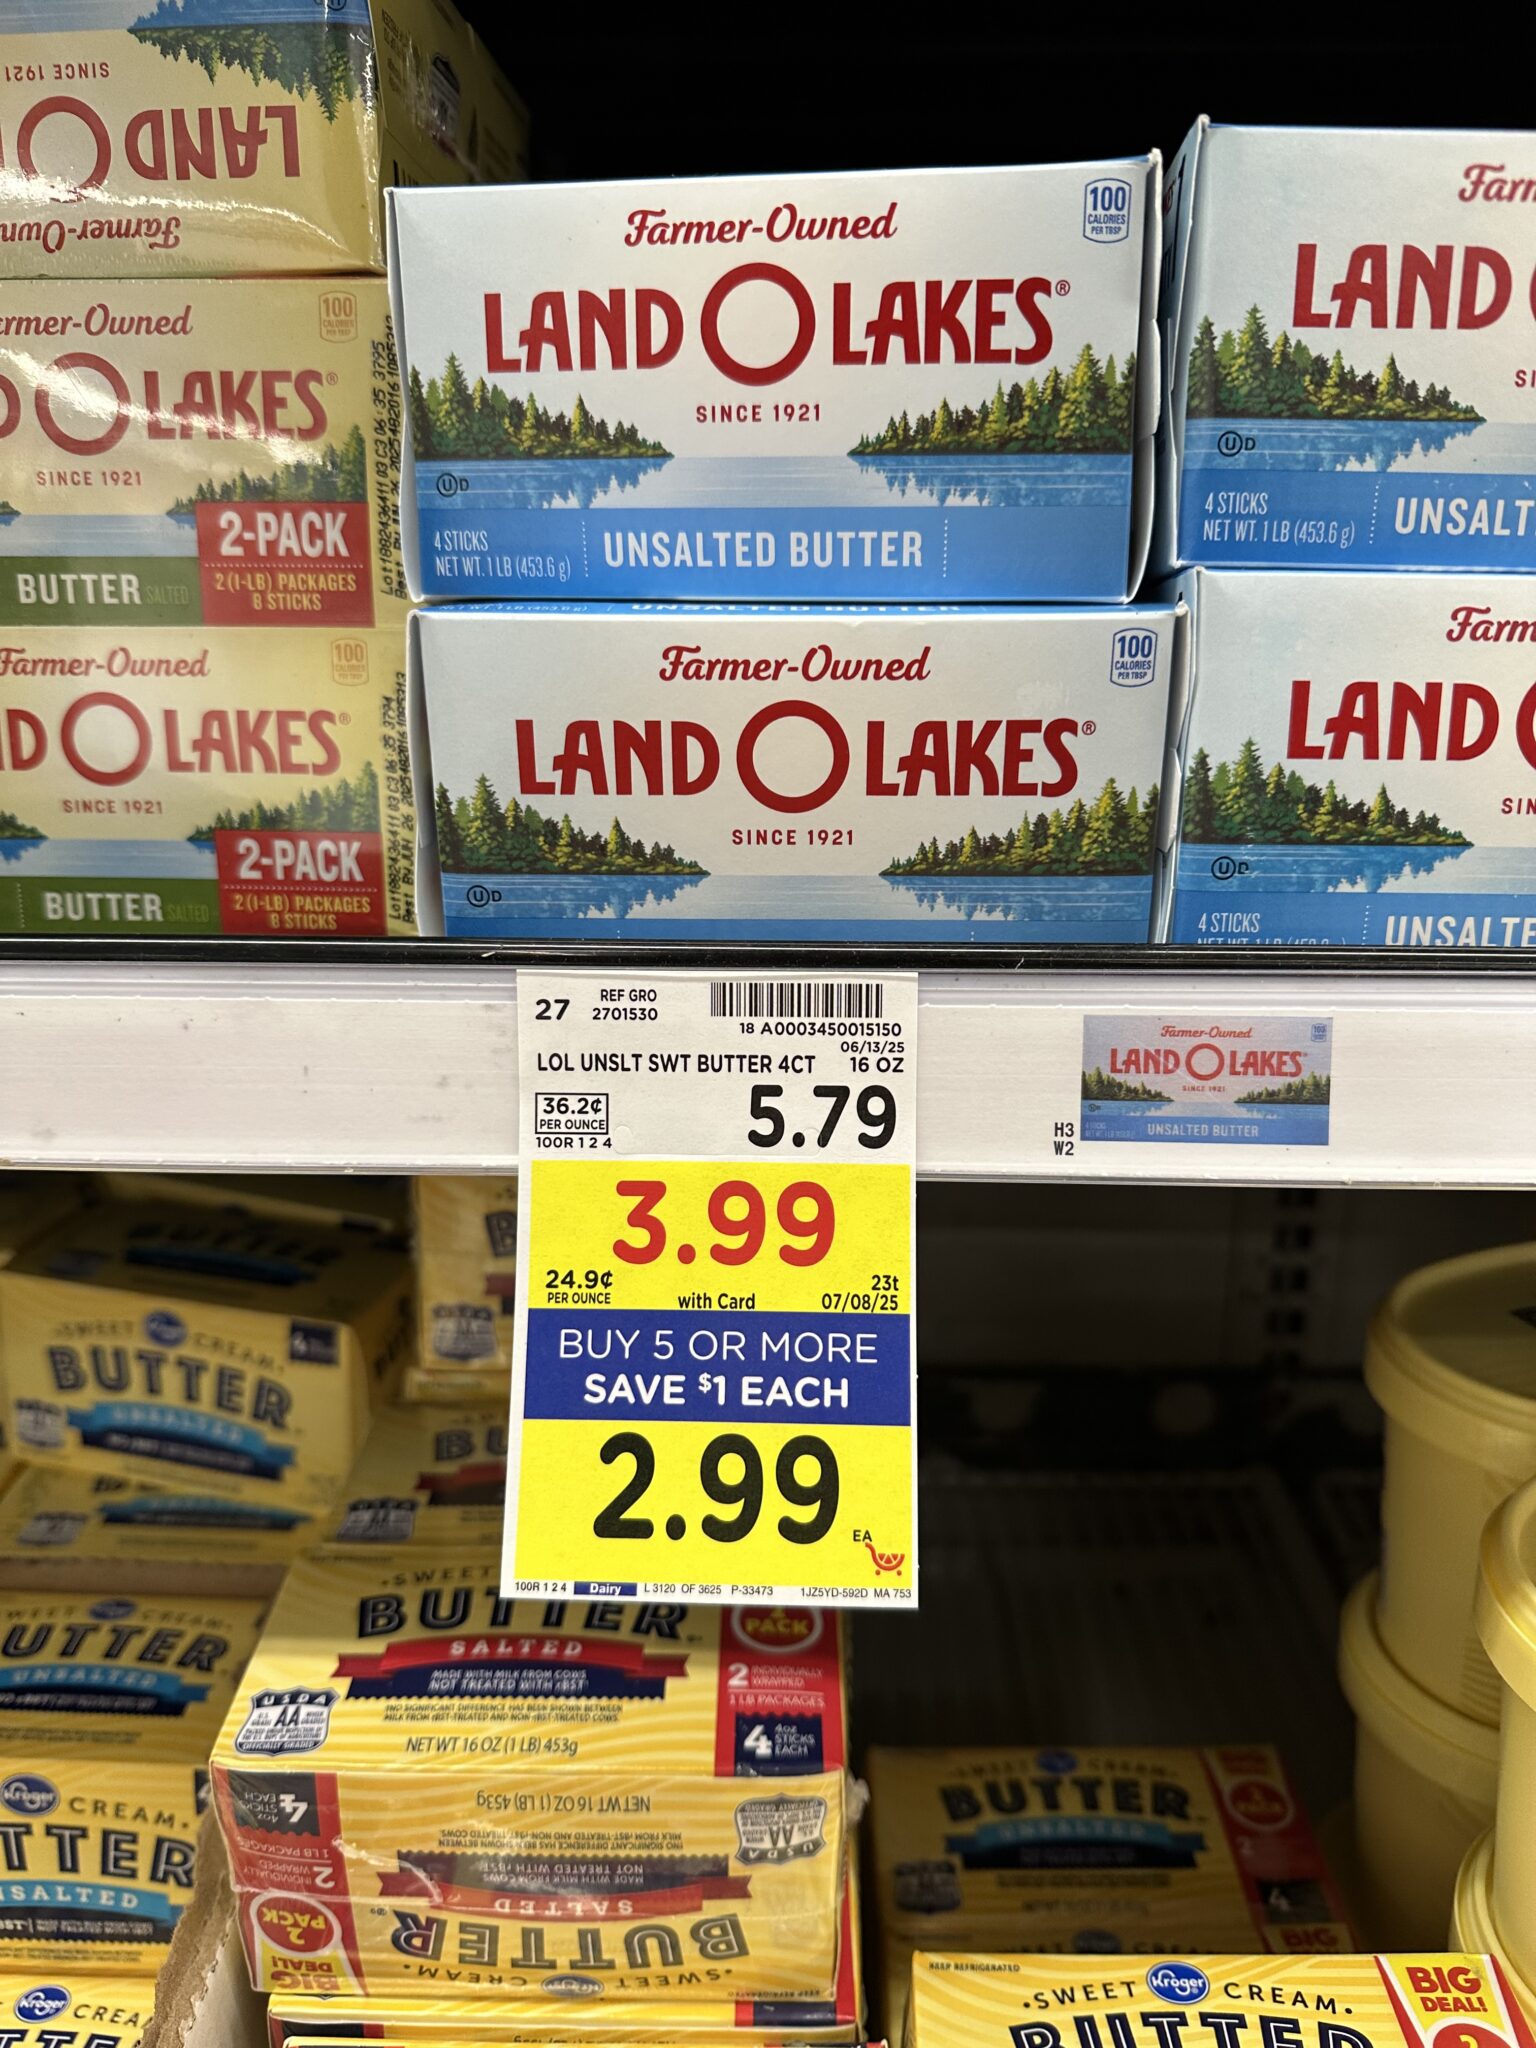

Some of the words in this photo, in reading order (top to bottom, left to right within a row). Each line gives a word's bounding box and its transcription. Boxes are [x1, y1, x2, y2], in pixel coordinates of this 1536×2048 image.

[5, 64, 45, 82] 1921
[54, 62, 110, 79] SINCE
[17, 95, 112, 203] O
[124, 105, 301, 181] LAND
[1089, 186, 1127, 212] 100
[624, 201, 898, 248] Farmer-Owned
[1292, 243, 1513, 330] LAND
[484, 288, 684, 374] LAND
[701, 262, 816, 387] O
[696, 404, 762, 423] SINCE
[773, 403, 821, 422] 1921
[36, 471, 93, 487] SINCE
[101, 471, 142, 486] 1921
[218, 511, 350, 559] 2-PACK
[433, 531, 443, 552] 4
[444, 530, 488, 552] STICKS
[603, 531, 776, 568] UNSALTED
[790, 531, 923, 568] BUTTER
[436, 557, 459, 578] NET
[462, 557, 486, 578] WT.
[487, 557, 494, 578] 1
[495, 557, 513, 578] LB
[515, 556, 556, 581] (453.6
[558, 557, 572, 582] g)
[16, 573, 142, 606] BUTTER
[1117, 636, 1152, 659] 100
[0, 647, 211, 677] Farmer-Owned
[659, 644, 932, 682] Farmer-Owned
[1286, 679, 1500, 762] LAND
[61, 691, 153, 787] O
[515, 719, 721, 796] LAND
[736, 700, 850, 814] O
[63, 800, 116, 815] SINCE
[125, 800, 163, 814] 1921
[732, 829, 797, 846] SINCE
[807, 829, 853, 846] 1921
[236, 838, 365, 882] 2-PACK
[44, 891, 164, 922] BUTTER
[295, 894, 371, 913] PACKAGES
[270, 913, 280, 929] 8
[283, 913, 337, 930] STICKS
[600, 989, 625, 1002] REF
[628, 989, 657, 1002] GRO
[535, 999, 571, 1020] 27
[592, 1007, 659, 1021] 2701530
[739, 1022, 756, 1034] 18
[760, 1022, 902, 1037] A0003450015150
[1160, 1025, 1253, 1039] Farmer-Owned
[840, 1041, 905, 1054] 06/13/25
[537, 1052, 574, 1073] LOL
[581, 1053, 642, 1073] UNSLT
[648, 1053, 691, 1073] SWT
[697, 1054, 772, 1073] BUTTER
[778, 1055, 816, 1074] 4CT
[849, 1057, 870, 1072] 16
[876, 1057, 904, 1073] OZ
[1110, 1048, 1180, 1075] LAND
[1185, 1043, 1225, 1081] O
[542, 1097, 602, 1115] 36.2¢
[747, 1084, 897, 1150] 5.79
[540, 1119, 562, 1130] PER
[564, 1119, 607, 1130] OUNCE
[1054, 1122, 1074, 1138] H3
[1148, 1123, 1208, 1137] UNSALTED
[1213, 1124, 1259, 1138] BUTTER
[536, 1137, 574, 1149] 100R
[578, 1137, 584, 1149] 1
[589, 1137, 598, 1149] 2
[602, 1138, 612, 1149] 4
[1054, 1141, 1074, 1156] W2
[612, 1180, 836, 1267] 3.99
[545, 1269, 614, 1290] 24.9¢
[870, 1274, 899, 1291] 23t
[547, 1292, 569, 1304] PER
[572, 1292, 611, 1304] OUNCE
[678, 1293, 712, 1309] with
[717, 1293, 756, 1310] Card
[821, 1294, 899, 1313] 07/08/25
[559, 1328, 641, 1359] BUY
[654, 1329, 675, 1360] 5
[689, 1330, 747, 1361] OR
[761, 1332, 878, 1364] MORE
[46, 1345, 294, 1429] BUTTER
[583, 1373, 686, 1405] SAVE
[698, 1372, 726, 1406] $1
[742, 1376, 849, 1408] EACH
[593, 1431, 840, 1544] 2.99
[853, 1530, 873, 1543] EA
[392, 1565, 494, 1584] SWEET
[514, 1582, 540, 1592] 100R
[543, 1583, 548, 1592] 1
[551, 1583, 558, 1593] 2
[560, 1583, 567, 1593] 4
[589, 1582, 622, 1596] Dairy
[643, 1584, 650, 1593] L
[652, 1584, 676, 1594] 3120
[680, 1584, 696, 1594] OF
[698, 1585, 722, 1595] 3625
[731, 1585, 774, 1597] P-33473
[874, 1588, 890, 1598] MA
[893, 1588, 912, 1599] 753
[359, 1586, 688, 1641] BUTTER
[2, 1622, 230, 1672] UTTER
[450, 1639, 582, 1656] SALTED
[728, 1662, 748, 1687] 2
[260, 1693, 327, 1706] USDA
[274, 1705, 301, 1727] AA
[407, 1737, 434, 1752] NET
[437, 1737, 460, 1752] WT
[463, 1737, 477, 1752] 16
[481, 1737, 500, 1752] OZ
[504, 1737, 516, 1755] (1
[520, 1737, 541, 1755] LB)
[543, 1738, 578, 1756] 453g
[744, 1724, 773, 1758] 4
[3, 1780, 56, 1811] Kroger
[939, 1775, 1192, 1822] BUTTER
[69, 1796, 175, 1828] CREAM
[0, 1823, 197, 1888] TTER
[262, 1907, 326, 1930] PACK
[495, 1899, 633, 1917] SALTED
[288, 1928, 305, 1945] 2
[391, 1910, 750, 1970] BUTTER
[271, 1956, 333, 1973] DEAL!
[953, 1961, 1021, 1974] REFRIGERATED
[271, 1973, 341, 1991] BIG
[418, 1965, 528, 1987] CREAM
[617, 1969, 721, 1988] SWEET
[1406, 1966, 1483, 1994] BIG
[1033, 1981, 1136, 2010] SWEET
[1151, 1969, 1204, 1996] Kroger
[1224, 1982, 1338, 2015] CREAM
[16, 1991, 67, 2017] Kroger
[1423, 1996, 1489, 2013] DEAL!
